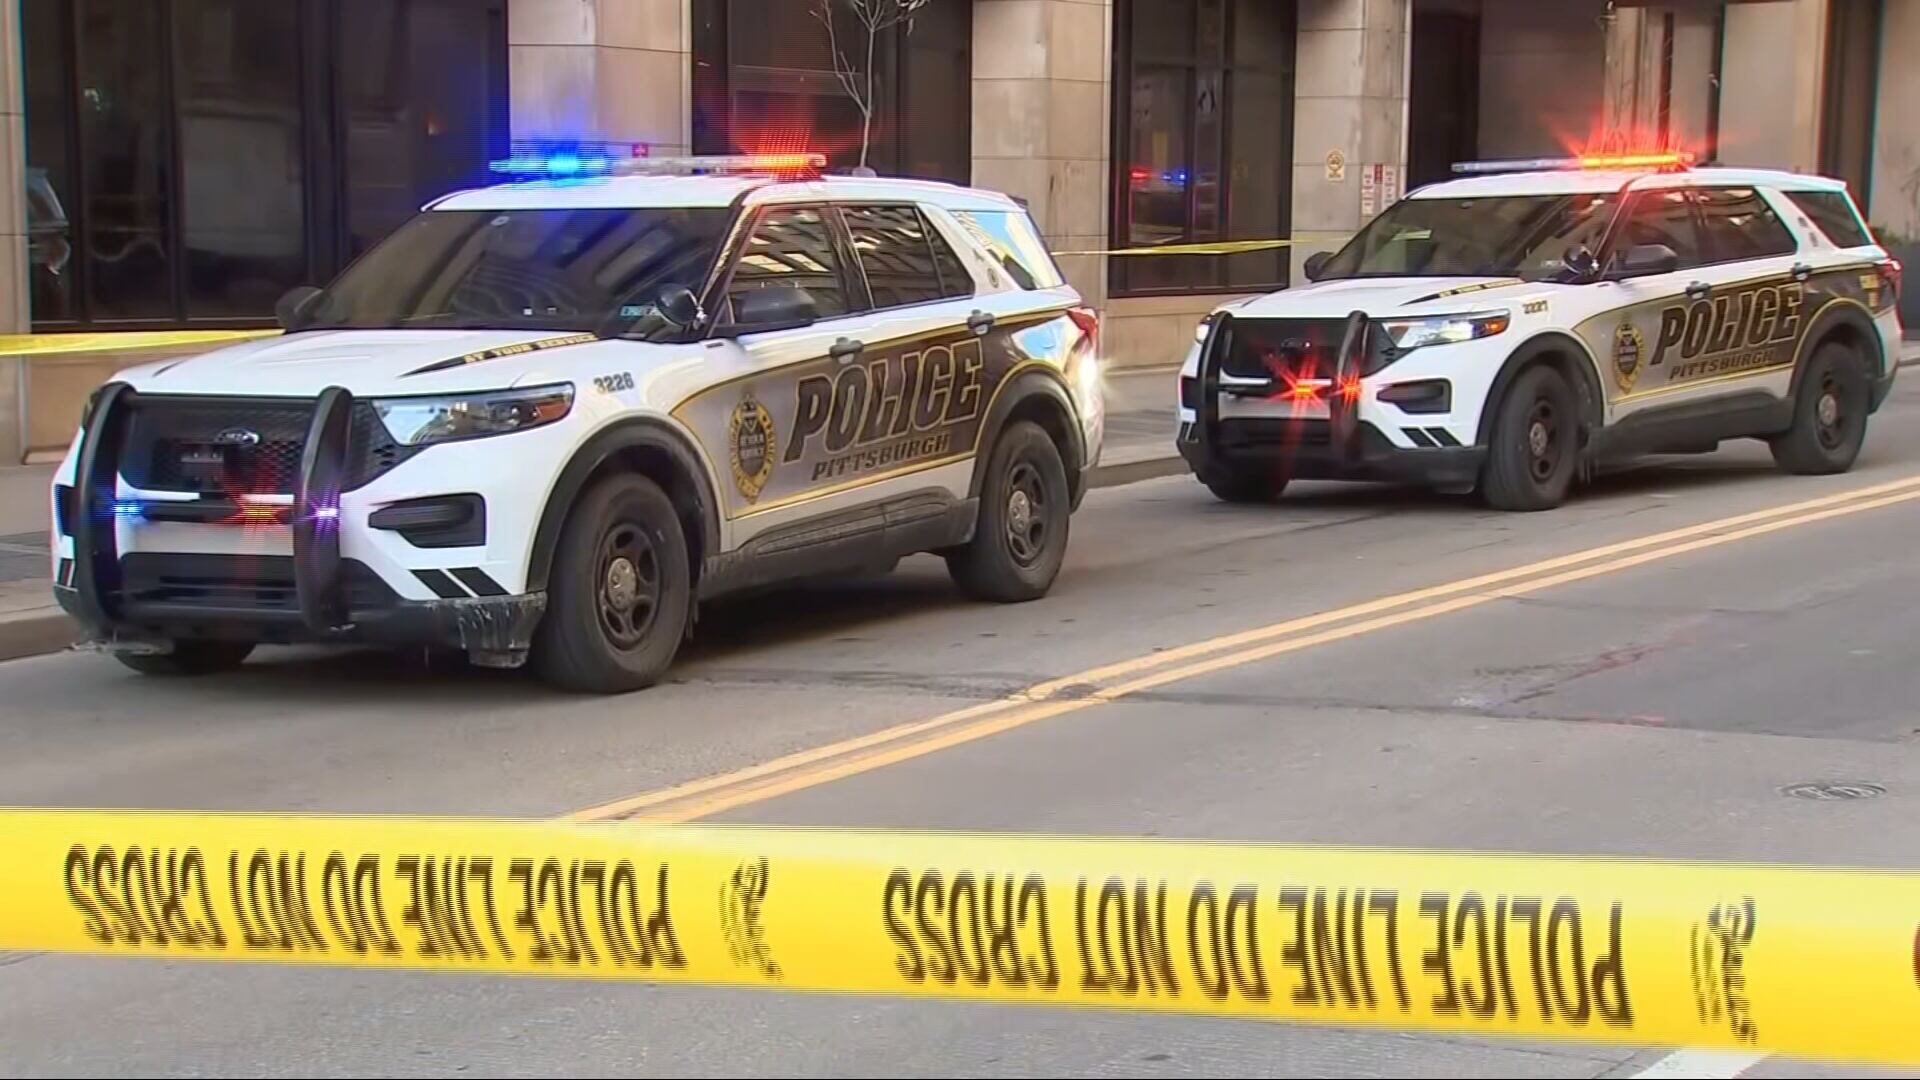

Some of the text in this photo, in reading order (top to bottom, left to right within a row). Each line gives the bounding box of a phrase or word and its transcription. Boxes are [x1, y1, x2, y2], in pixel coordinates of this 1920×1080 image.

[1650, 285, 1803, 366] POLICE
[1669, 350, 1773, 380] PITTSBURGH
[593, 371, 635, 394] 3226
[782, 337, 984, 466] POLICE
[810, 432, 951, 482] PITTSBURGH
[64, 843, 228, 951] CROSS
[228, 848, 329, 954] NOT
[321, 851, 403, 956] DO
[395, 854, 515, 963] LINE
[508, 857, 688, 971] POLICE
[882, 866, 1060, 993] CROSS
[1074, 875, 1182, 1000] NOT
[1186, 880, 1272, 1005] DO
[1278, 885, 1413, 1015] LINE
[1418, 891, 1634, 1029] POLICE
